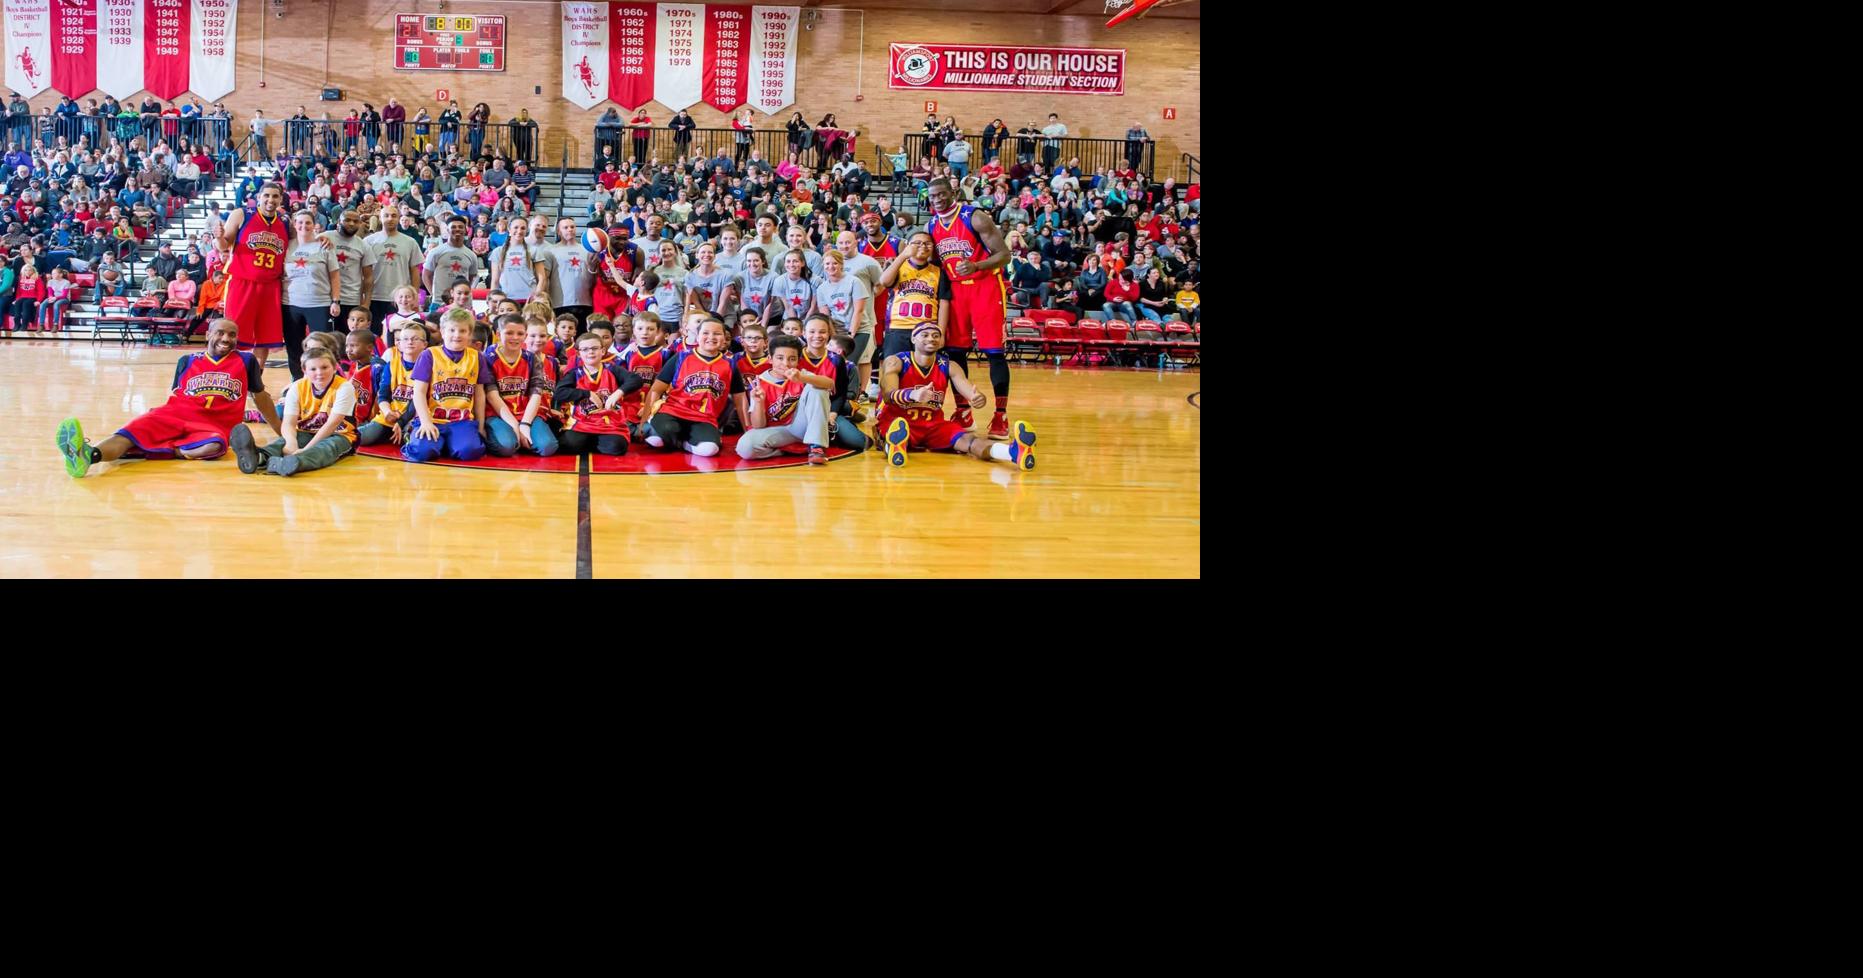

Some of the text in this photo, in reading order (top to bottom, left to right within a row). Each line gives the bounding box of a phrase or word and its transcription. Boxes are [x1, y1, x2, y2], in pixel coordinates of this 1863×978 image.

[61, 8, 83, 16] 1921
[156, 9, 179, 17] 1941
[617, 8, 648, 16] 1960s
[665, 9, 696, 17] 1970s
[713, 11, 743, 19] 1980s
[761, 12, 791, 20] 1990s
[61, 17, 84, 25] 1924
[621, 19, 644, 27] 1962
[669, 20, 692, 28] 1971
[717, 21, 739, 29] 1981
[61, 27, 84, 35] 1925
[156, 28, 179, 36] 1947
[202, 29, 224, 37] 1954
[621, 28, 644, 36] 1964
[717, 31, 740, 39] 1982
[61, 36, 84, 44] 1928
[109, 37, 131, 45] 1939
[156, 38, 179, 46] 1948
[621, 38, 644, 46] 1965
[669, 39, 692, 47] 1975
[716, 40, 739, 48] 1983
[61, 46, 84, 54] 1929
[156, 47, 179, 55] 1949
[202, 48, 224, 56] 1958
[621, 47, 643, 55] 1966
[716, 50, 738, 58] 1984
[763, 51, 785, 59] 1993
[621, 57, 643, 65] 1967
[668, 58, 691, 66] 1978
[716, 60, 738, 68] 1985
[944, 51, 1119, 73] THIS IS OUR HOUSE
[620, 66, 643, 74] 1968
[715, 69, 737, 77] 1986
[762, 70, 784, 78] 1995
[715, 79, 736, 87] 1987
[944, 73, 1118, 88] MILLIONAIRE STUDENT SECTION
[439, 91, 447, 100] D
[715, 88, 736, 96] 1988
[761, 89, 783, 97] 1997
[715, 97, 736, 105] 1989
[761, 99, 783, 107] 1999
[927, 102, 935, 112] B
[1165, 109, 1173, 119] A
[253, 251, 276, 268] 33
[188, 378, 241, 394] WIZARDS
[204, 396, 215, 409] 1
